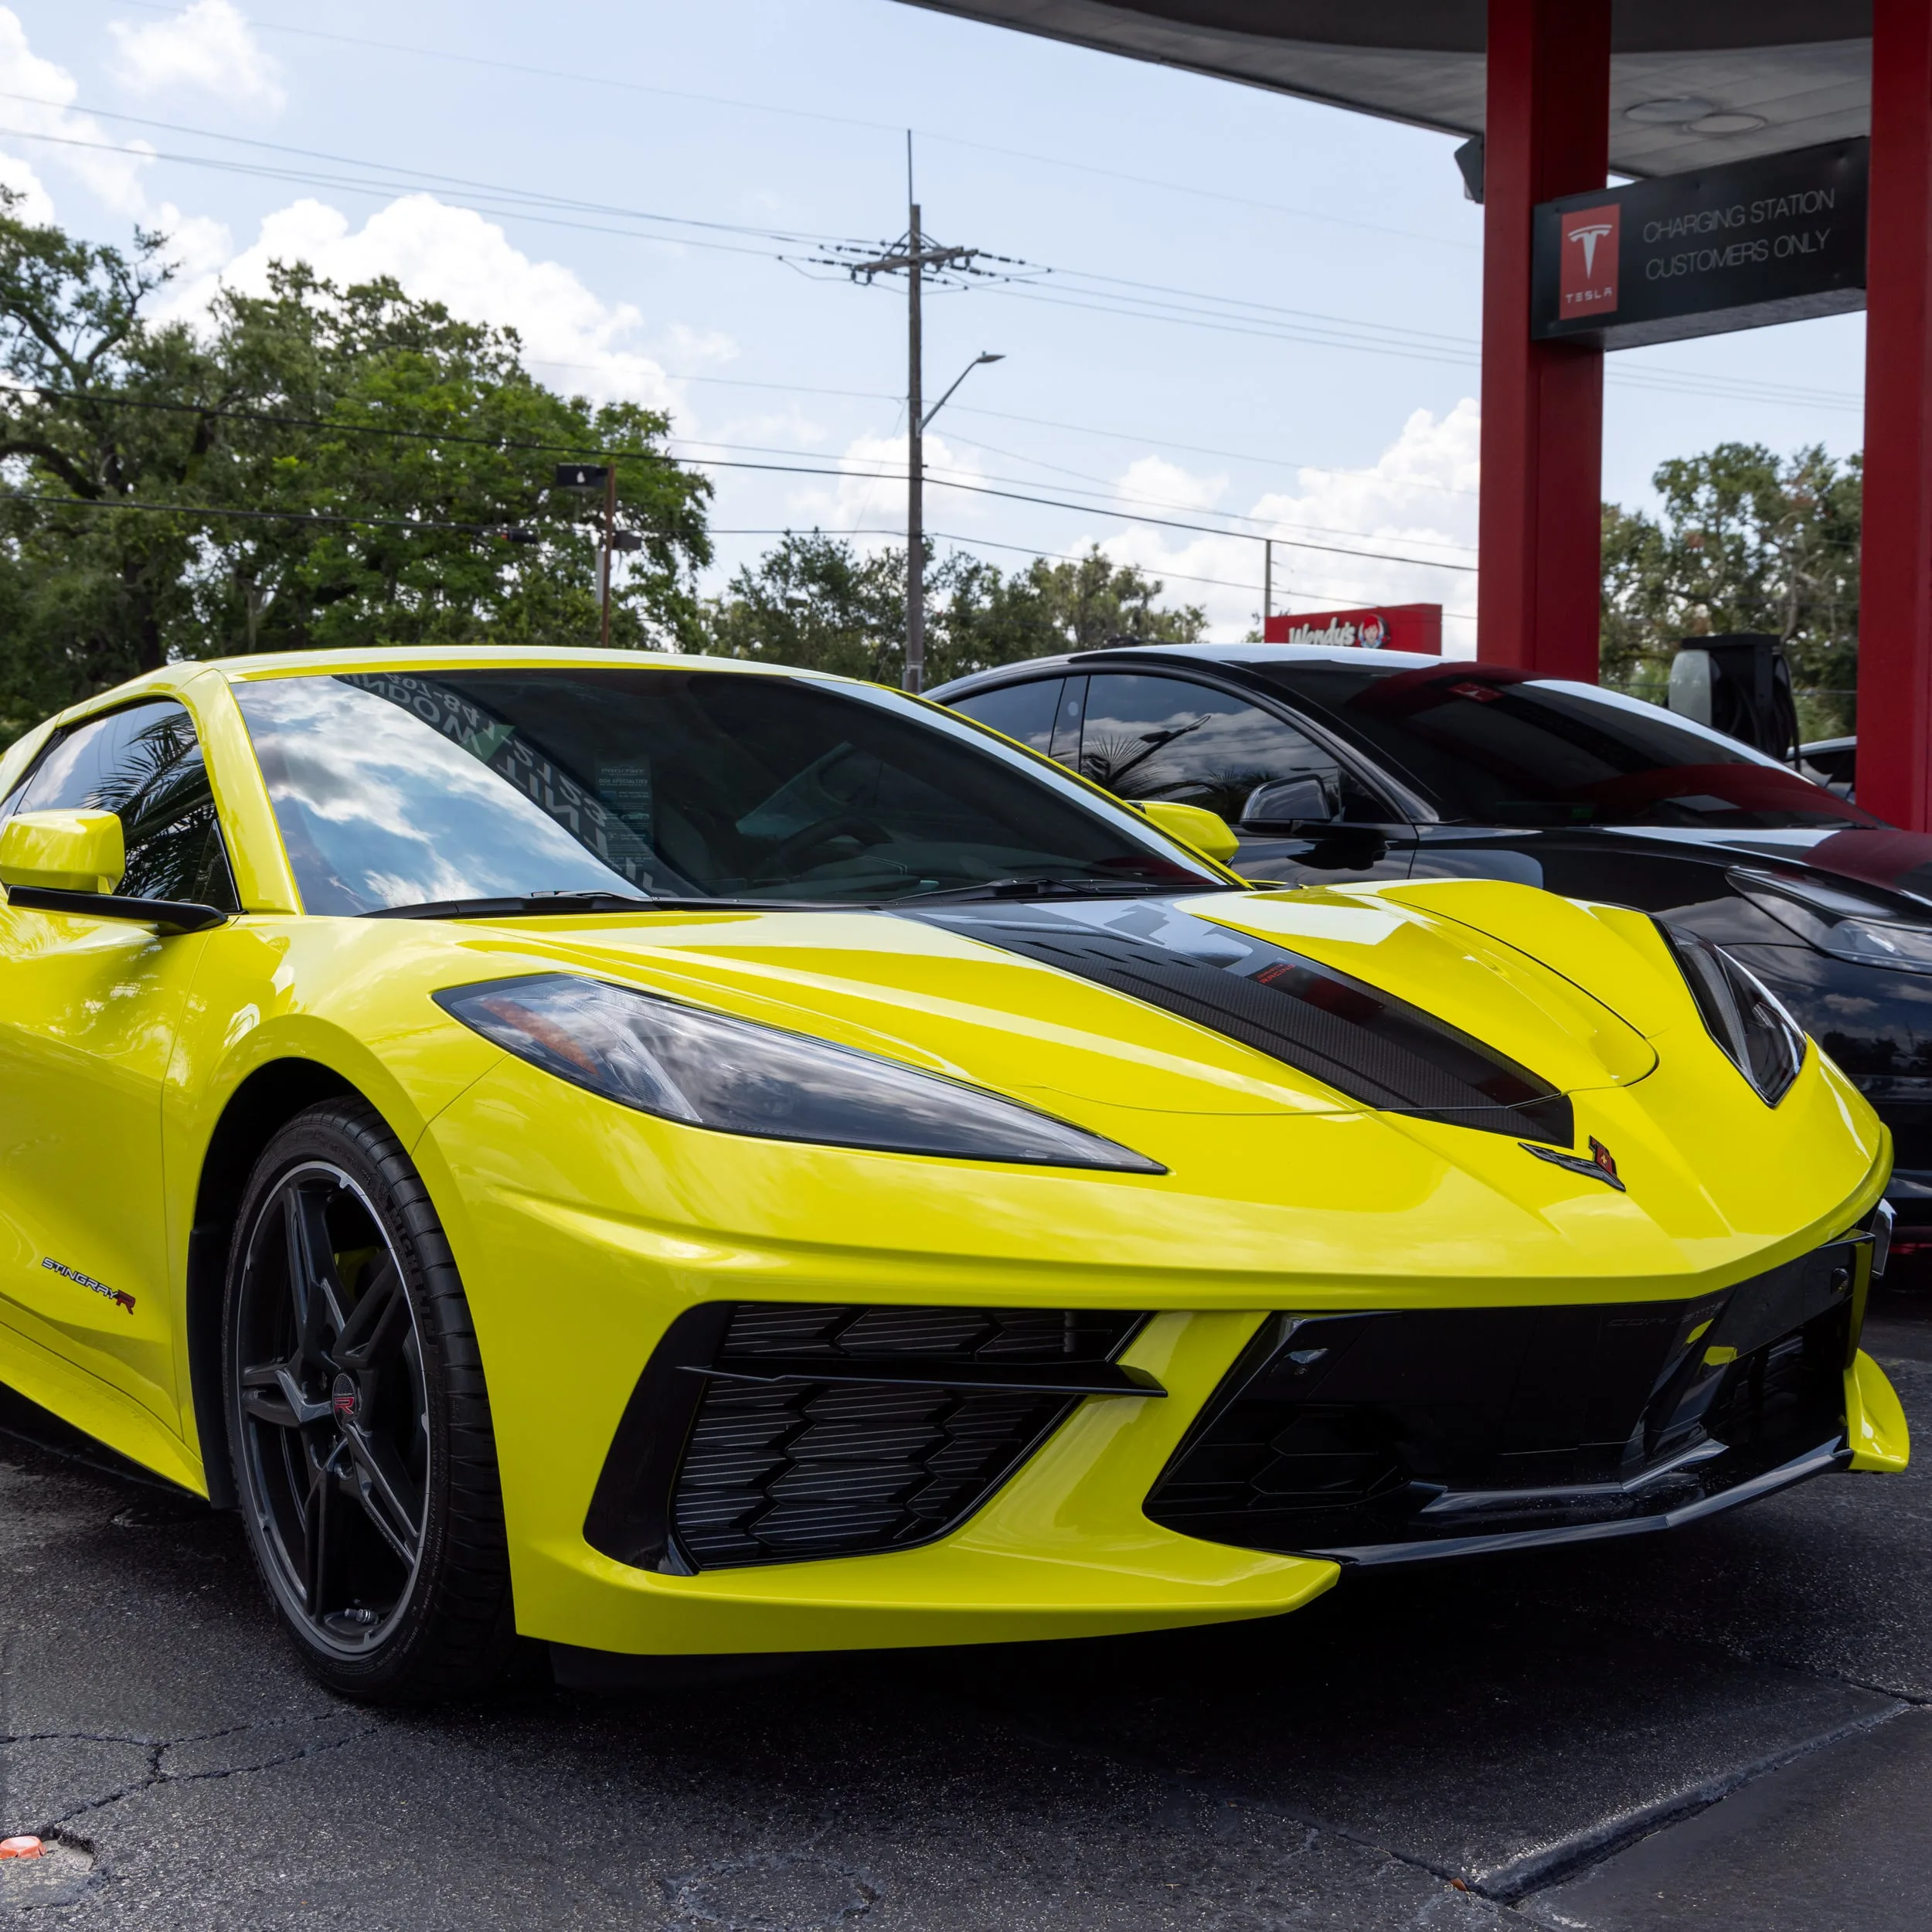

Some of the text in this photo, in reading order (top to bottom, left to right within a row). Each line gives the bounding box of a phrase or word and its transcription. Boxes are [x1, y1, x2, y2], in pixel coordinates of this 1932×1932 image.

[1643, 188, 1835, 243] CHARGING STATION
[1645, 228, 1832, 281] CUSTOMERS ONLY
[1565, 287, 1613, 304] TESLA
[1288, 617, 1355, 646] Wendy's
[1260, 964, 1296, 983] RACING
[42, 1257, 117, 1300] STINGRAY
